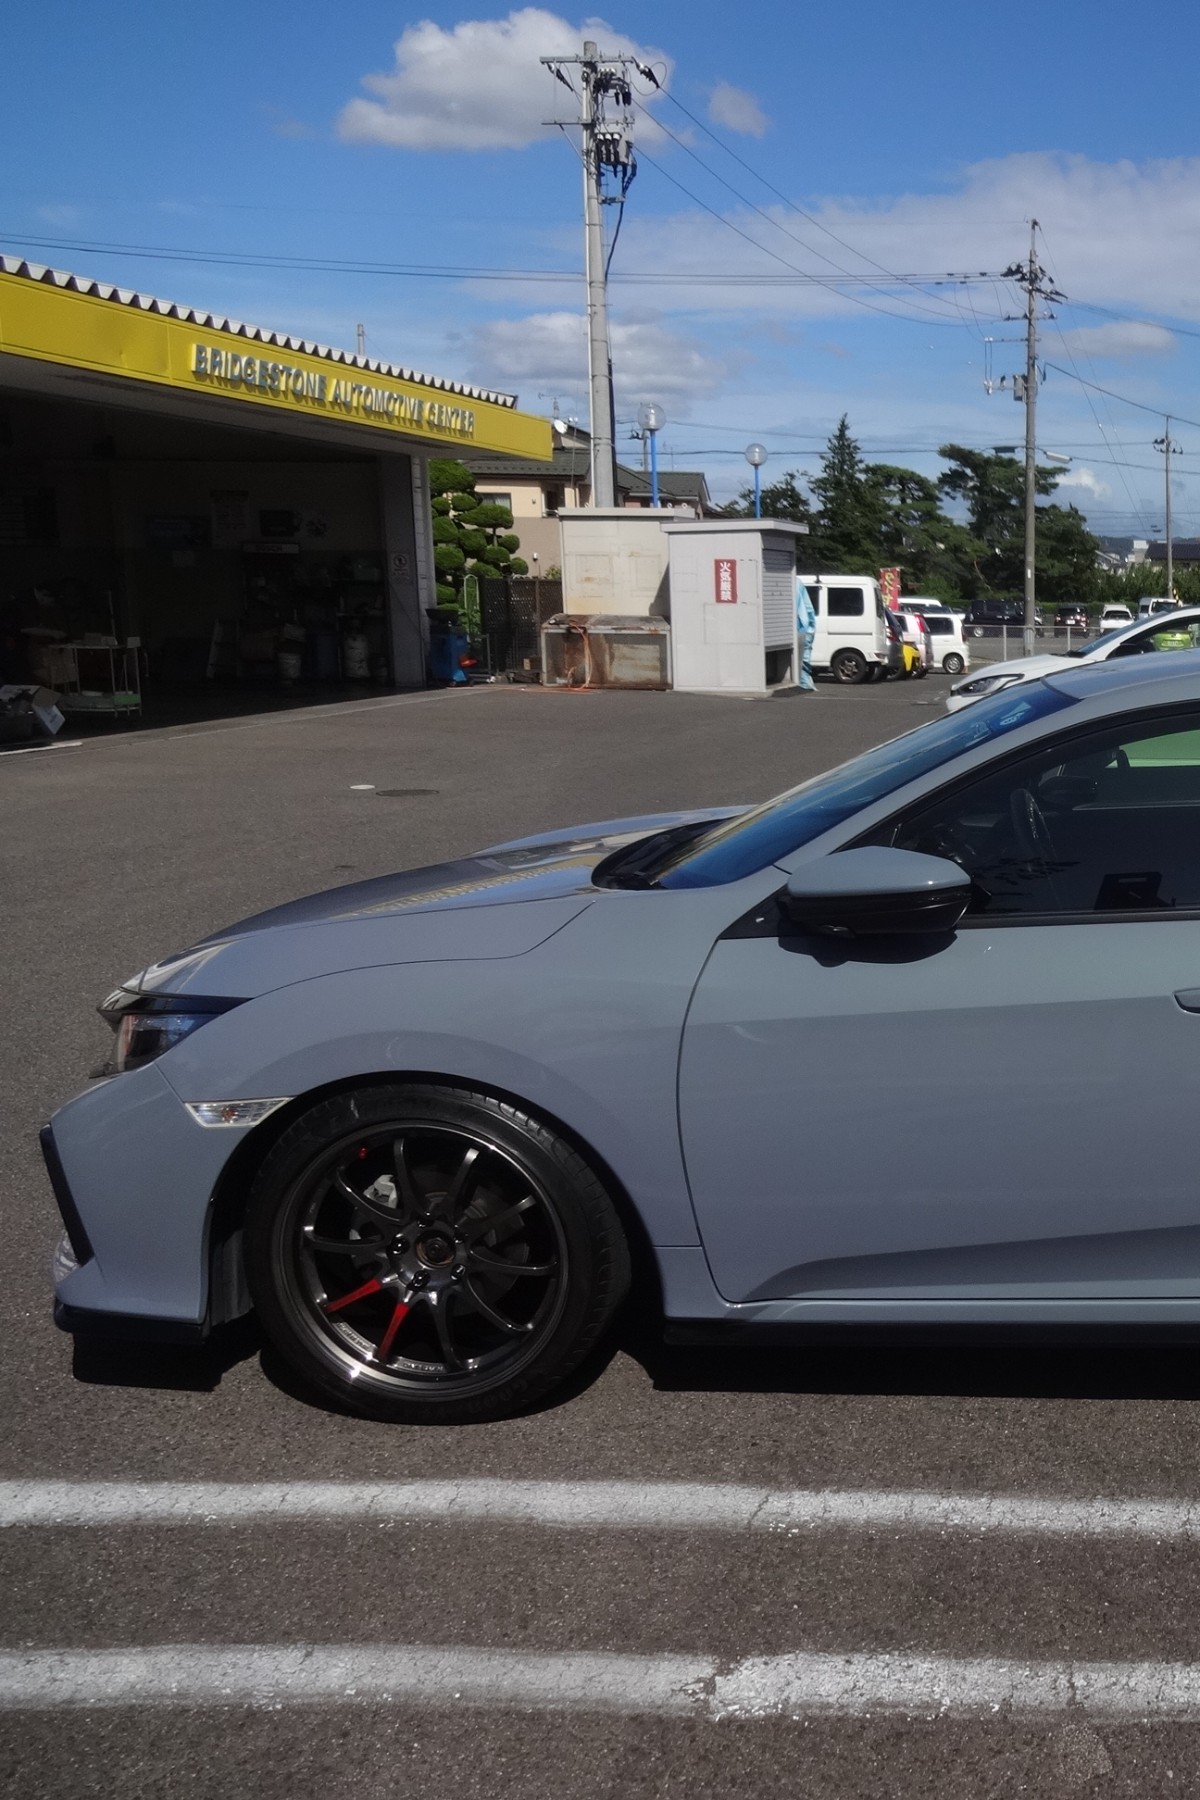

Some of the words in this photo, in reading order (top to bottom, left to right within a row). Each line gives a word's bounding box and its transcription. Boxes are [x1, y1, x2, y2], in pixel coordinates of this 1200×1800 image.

[192, 343, 328, 401] BRIDGESTONE
[328, 377, 424, 422] AUTOMOTIVE
[424, 401, 476, 434] CENTER
